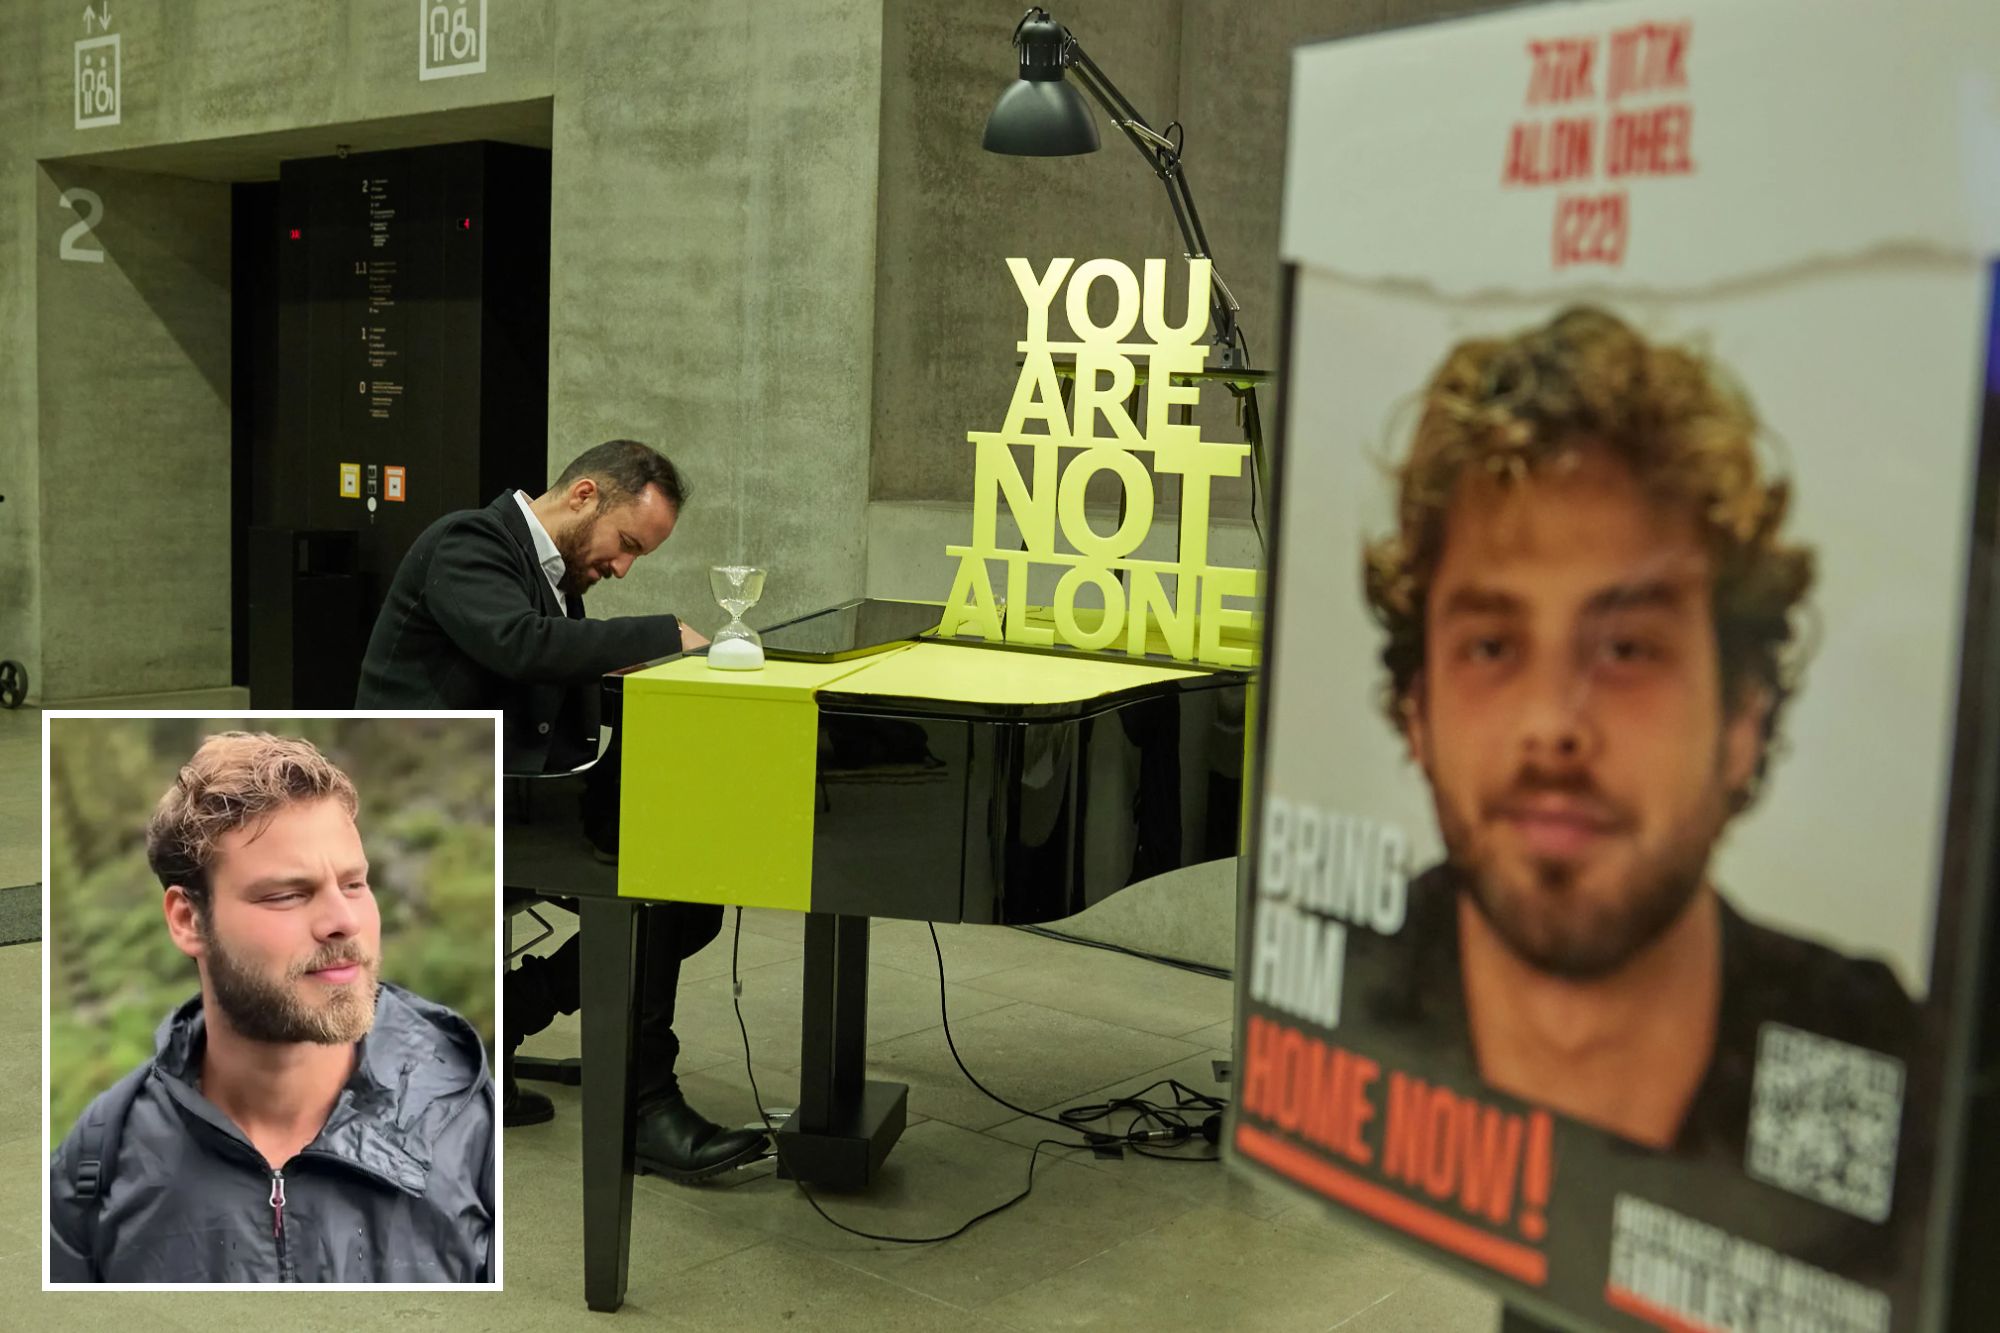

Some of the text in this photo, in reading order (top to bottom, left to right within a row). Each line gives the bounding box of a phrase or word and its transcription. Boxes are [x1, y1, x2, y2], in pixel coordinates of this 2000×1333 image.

[1504, 107, 1693, 187] ALON OHEL
[60, 187, 104, 263] 2
[1555, 195, 1626, 268] (22)
[1005, 257, 1212, 346] YOU
[1000, 348, 1208, 442] ARE
[970, 432, 1250, 566] NOT
[937, 558, 1260, 666] ALONE
[1261, 800, 1408, 935] BRING
[1249, 901, 1347, 1029] HIM
[1244, 1016, 1552, 1240] HOME NOW!
